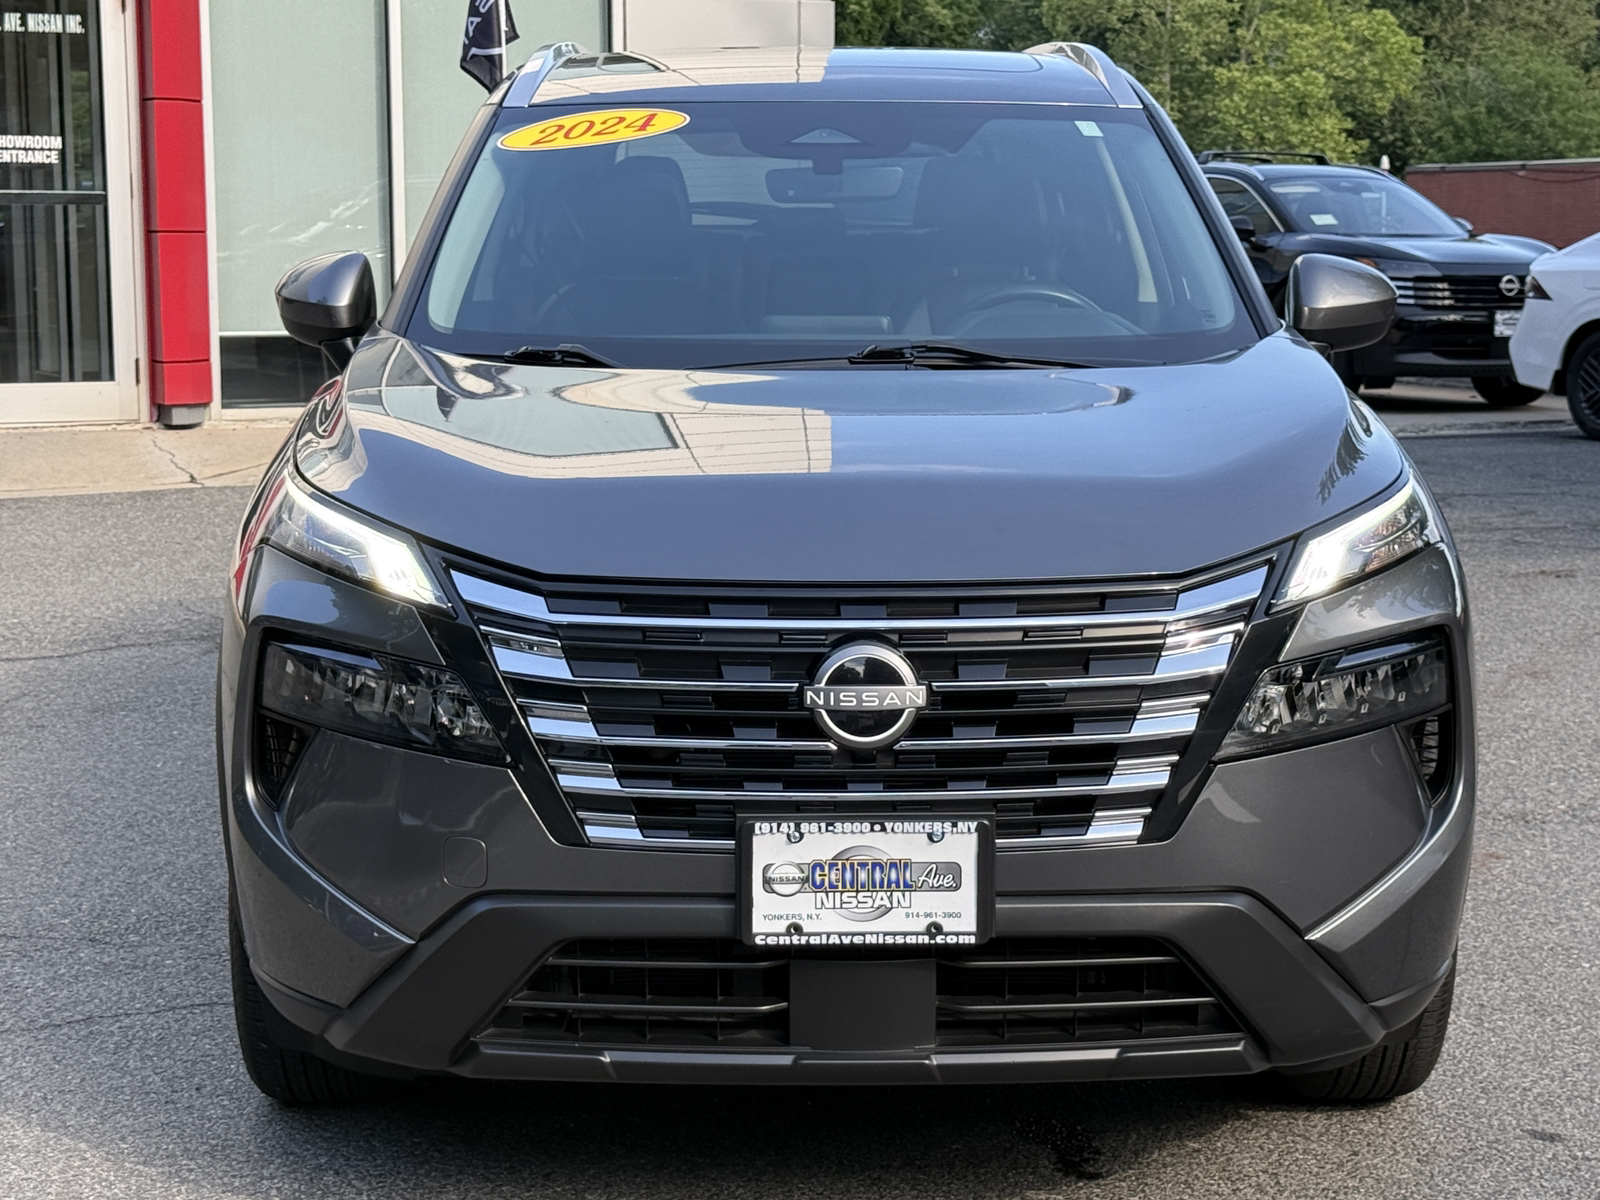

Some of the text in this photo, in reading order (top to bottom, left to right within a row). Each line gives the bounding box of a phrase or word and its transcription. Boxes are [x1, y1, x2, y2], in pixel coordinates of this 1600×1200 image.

[4, 12, 86, 34] AVE. NISSAN INC.
[530, 112, 658, 146] 2024
[0, 135, 63, 150] HOWROOM
[806, 690, 923, 706] NISSAN
[800, 822, 871, 833] 961-3900
[809, 859, 957, 891] CENTRAL Ave.
[815, 891, 911, 909] NISSAN
[762, 913, 806, 921] YONKERS,
[754, 933, 976, 945] CentralAveNissan.com
